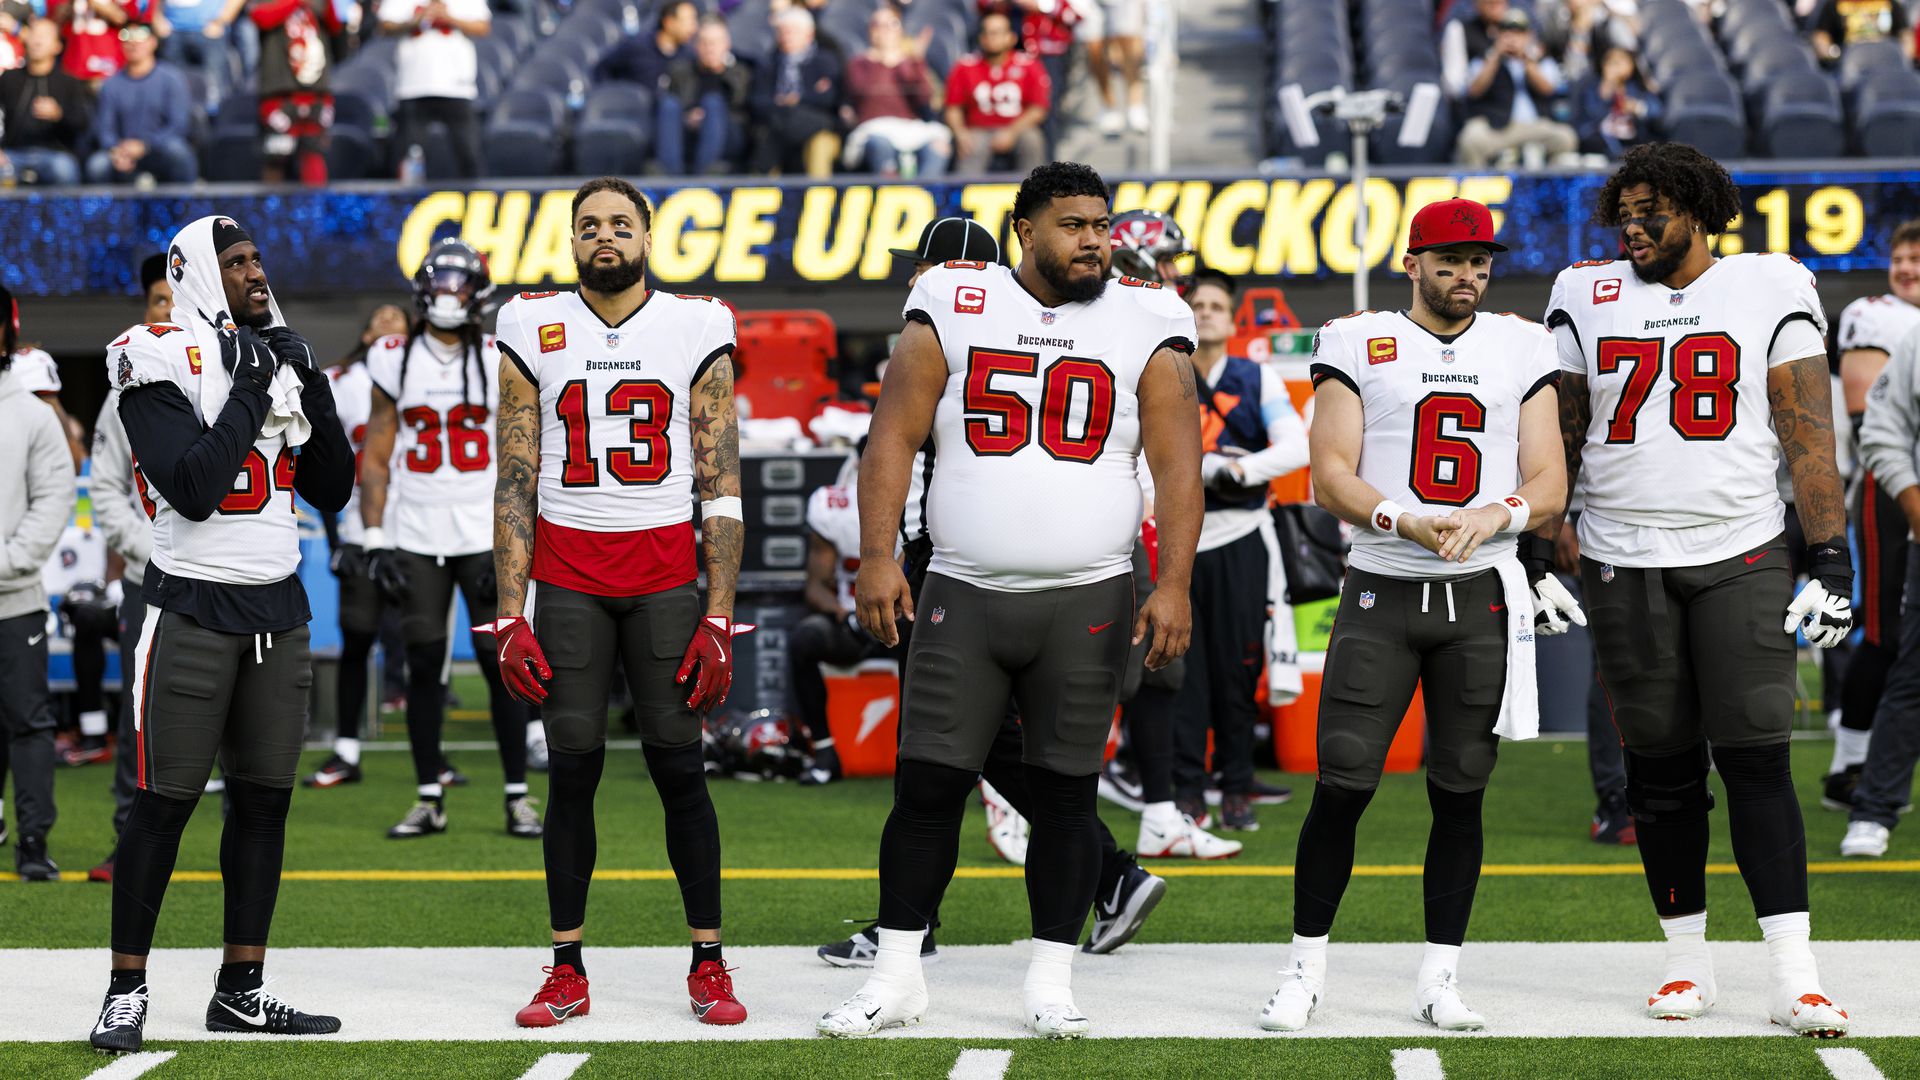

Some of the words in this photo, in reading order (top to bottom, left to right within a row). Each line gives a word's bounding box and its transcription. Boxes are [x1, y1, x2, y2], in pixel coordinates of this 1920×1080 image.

[397, 186, 782, 285] CHAGE
[792, 184, 937, 281] UP
[960, 183, 1024, 270] T
[957, 287, 984, 307] C
[1595, 279, 1620, 297] C
[1644, 315, 1701, 331] BUCCANEERS
[541, 324, 564, 345] C
[1017, 334, 1075, 350] BUCCANEERS
[1370, 338, 1395, 357] C
[585, 360, 642, 373] BUCCANEERS
[1421, 373, 1480, 386] BUCCANEERS
[1597, 331, 1742, 445] 78
[963, 345, 1116, 465] 50
[402, 403, 491, 474] 36
[555, 378, 675, 488] 13
[1408, 390, 1487, 508] 6
